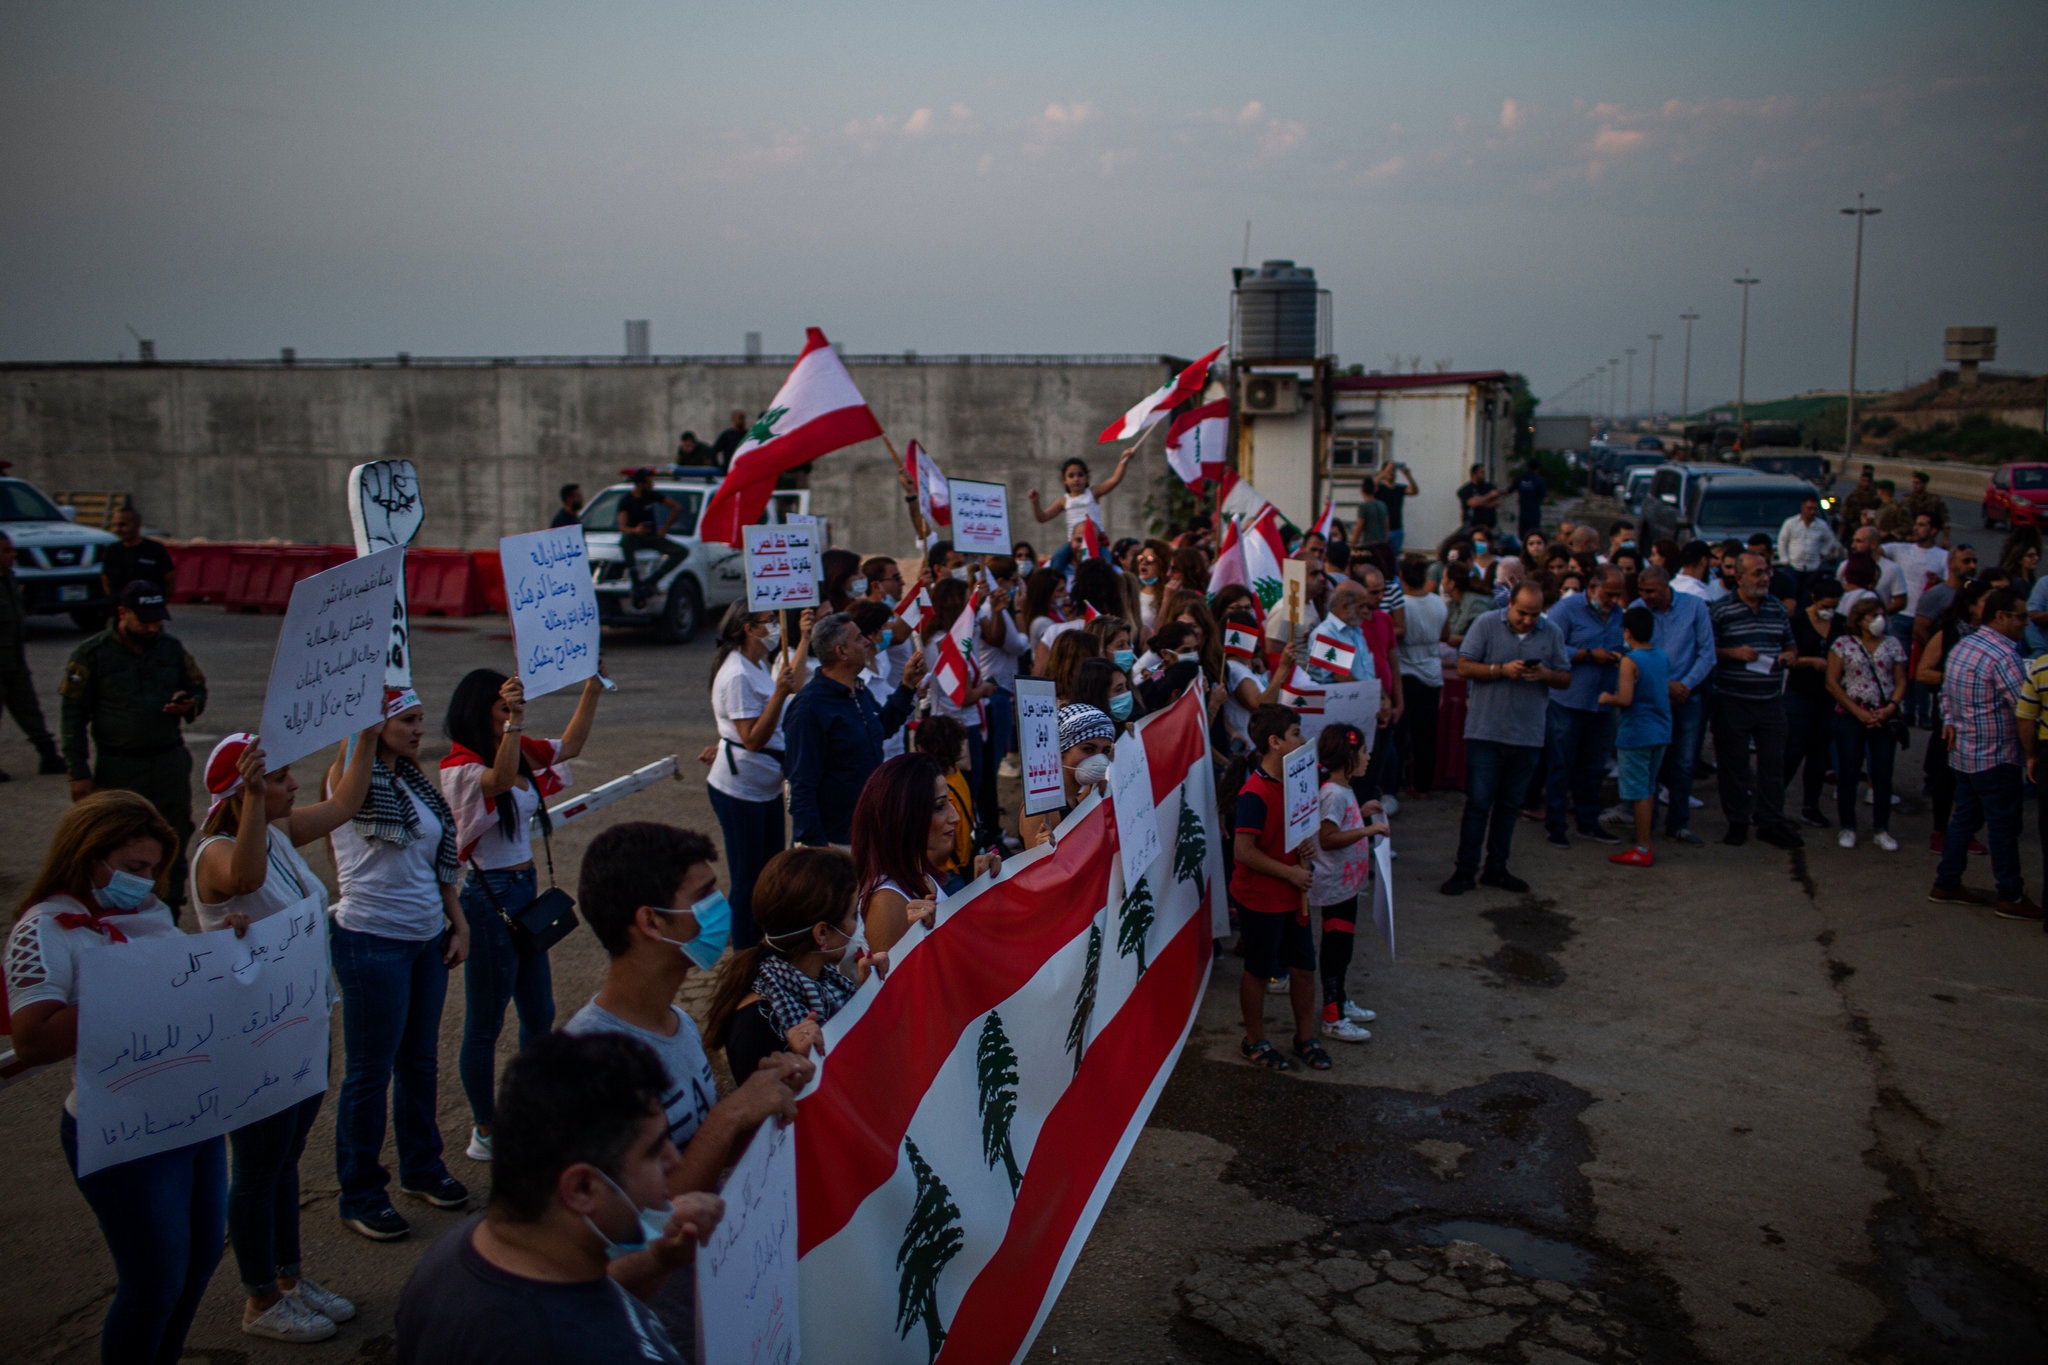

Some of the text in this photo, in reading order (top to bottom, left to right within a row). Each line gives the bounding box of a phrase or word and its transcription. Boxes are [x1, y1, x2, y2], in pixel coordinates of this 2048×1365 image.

[242, 982, 294, 1034] للمحارق
[303, 969, 318, 1008] لا
[98, 1025, 180, 1074] للمطامر
[186, 1013, 214, 1054] لا
